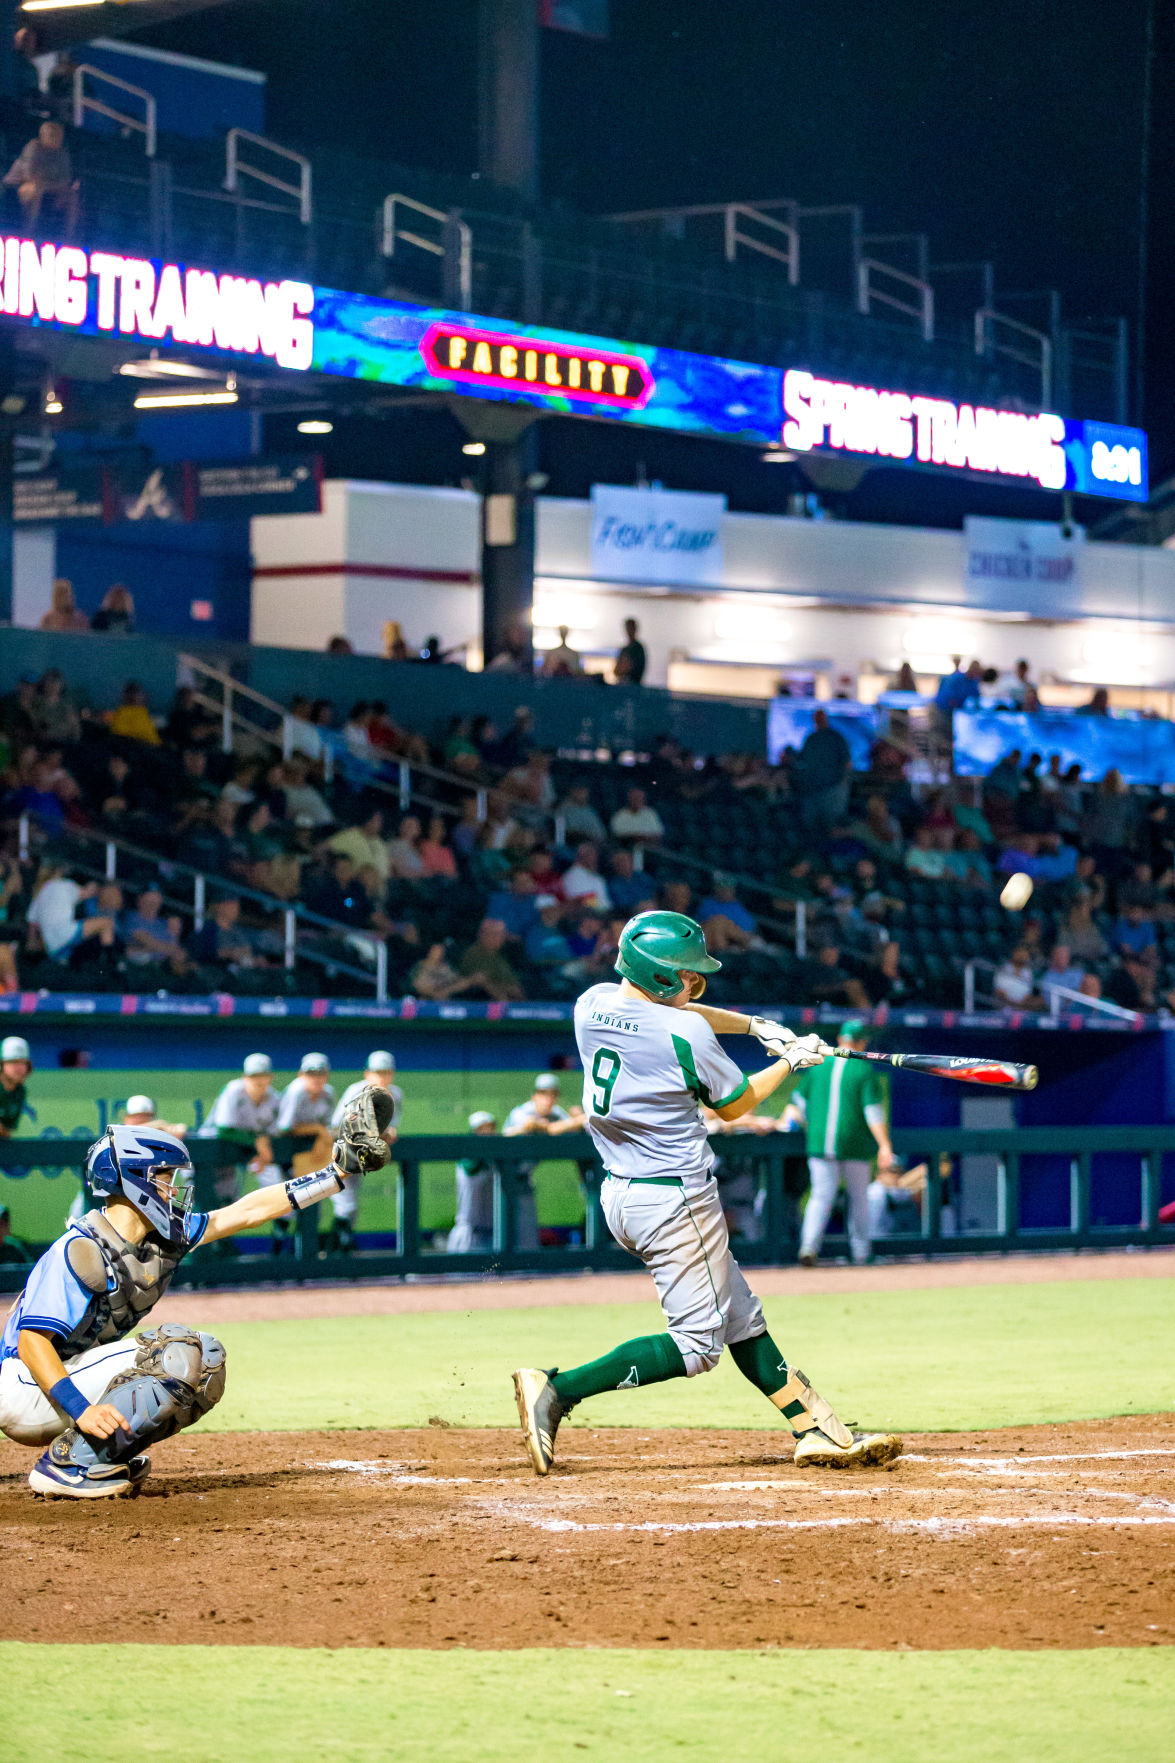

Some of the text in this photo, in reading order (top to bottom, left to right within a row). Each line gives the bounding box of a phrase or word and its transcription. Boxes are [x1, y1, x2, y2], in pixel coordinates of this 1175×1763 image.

[90, 251, 314, 370] TRAINING
[449, 336, 629, 396] FACILITY
[783, 369, 1066, 490] SPRING TRAINING
[592, 1011, 639, 1033] INDIANS
[592, 1046, 623, 1117] 9
